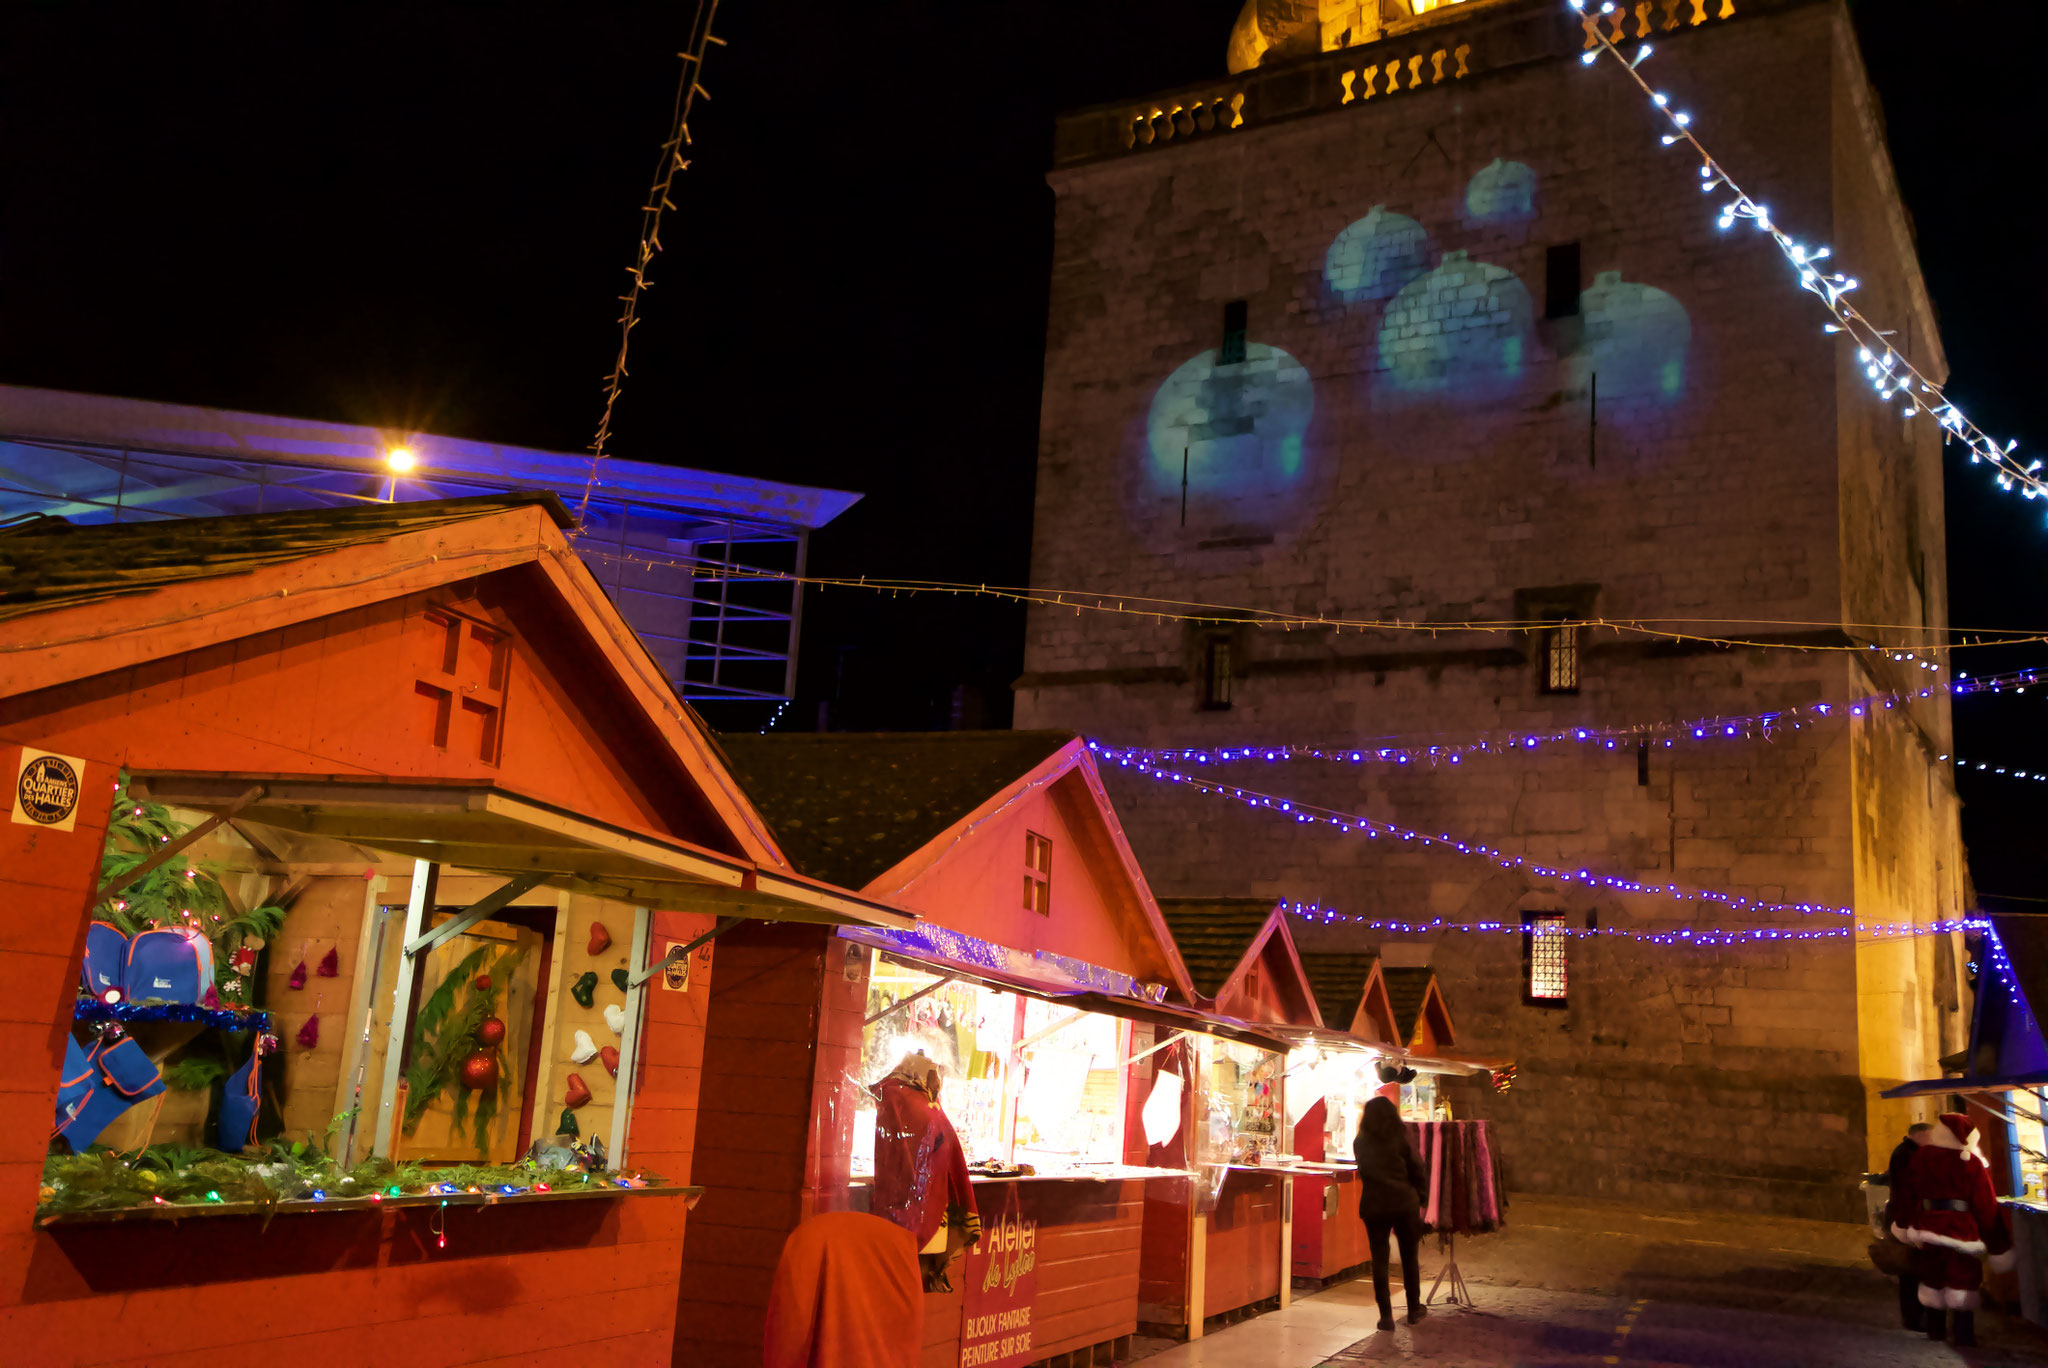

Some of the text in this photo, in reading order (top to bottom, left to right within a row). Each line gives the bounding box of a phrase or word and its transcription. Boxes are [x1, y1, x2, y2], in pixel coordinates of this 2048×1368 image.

[23, 777, 75, 799] QUARTIER
[45, 776, 67, 788] AMIENS
[23, 792, 72, 808] DES HALLES
[967, 1306, 1031, 1339] BIJOUX FANTAISIE
[962, 1331, 1032, 1368] PEINTURE SUR SOIE
